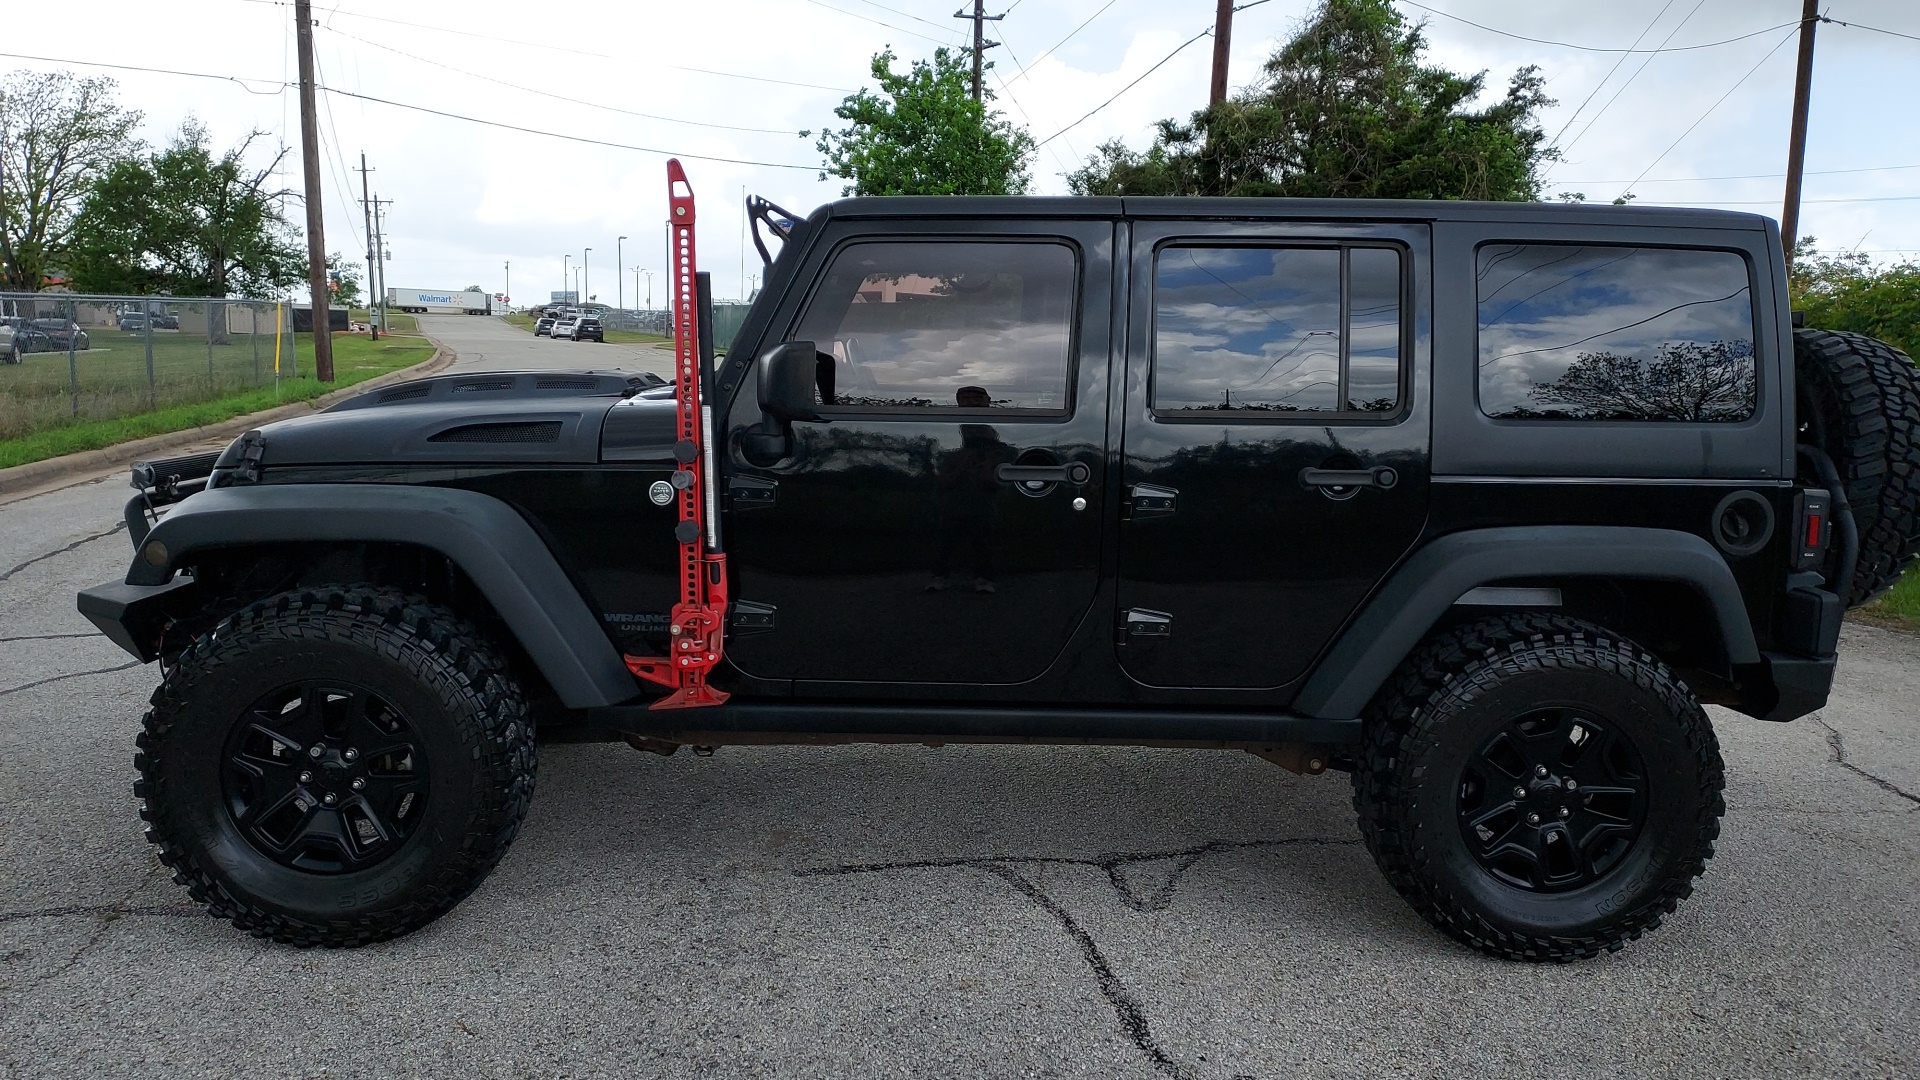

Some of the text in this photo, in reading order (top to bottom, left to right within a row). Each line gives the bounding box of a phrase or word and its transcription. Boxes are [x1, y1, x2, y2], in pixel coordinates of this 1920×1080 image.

[418, 294, 452, 303] Walmart
[603, 613, 672, 623] WRANG
[620, 624, 669, 632] UNLIMI
